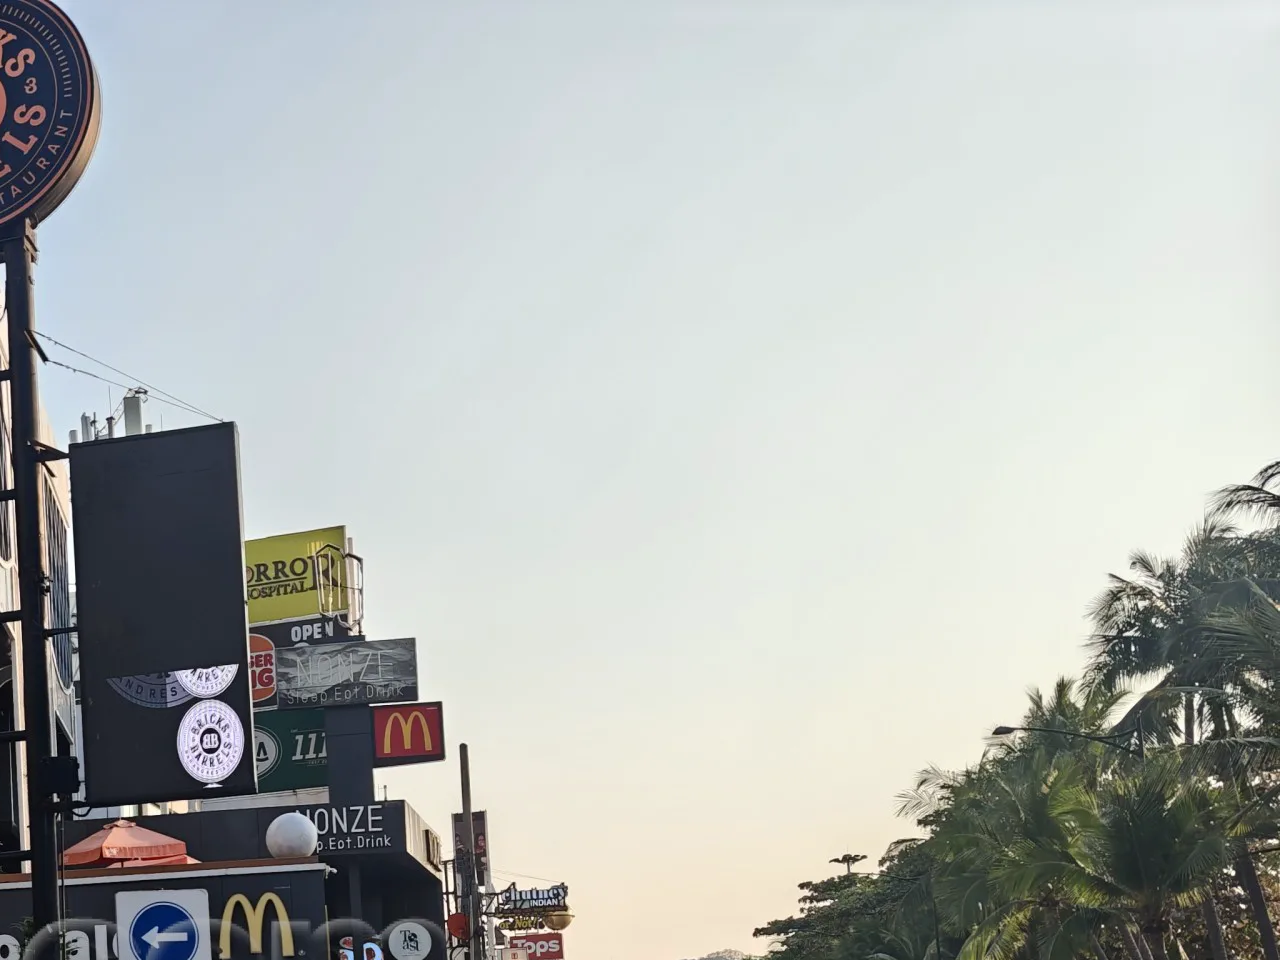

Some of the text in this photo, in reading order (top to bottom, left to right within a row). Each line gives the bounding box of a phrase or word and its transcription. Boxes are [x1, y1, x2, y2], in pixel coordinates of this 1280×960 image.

[291, 621, 334, 643] OPEN
[297, 650, 394, 688] NONZE
[501, 887, 566, 901] chutney
[531, 899, 558, 907] INDIAN
[499, 917, 538, 929] or Not!
[512, 939, 561, 957] Tops
